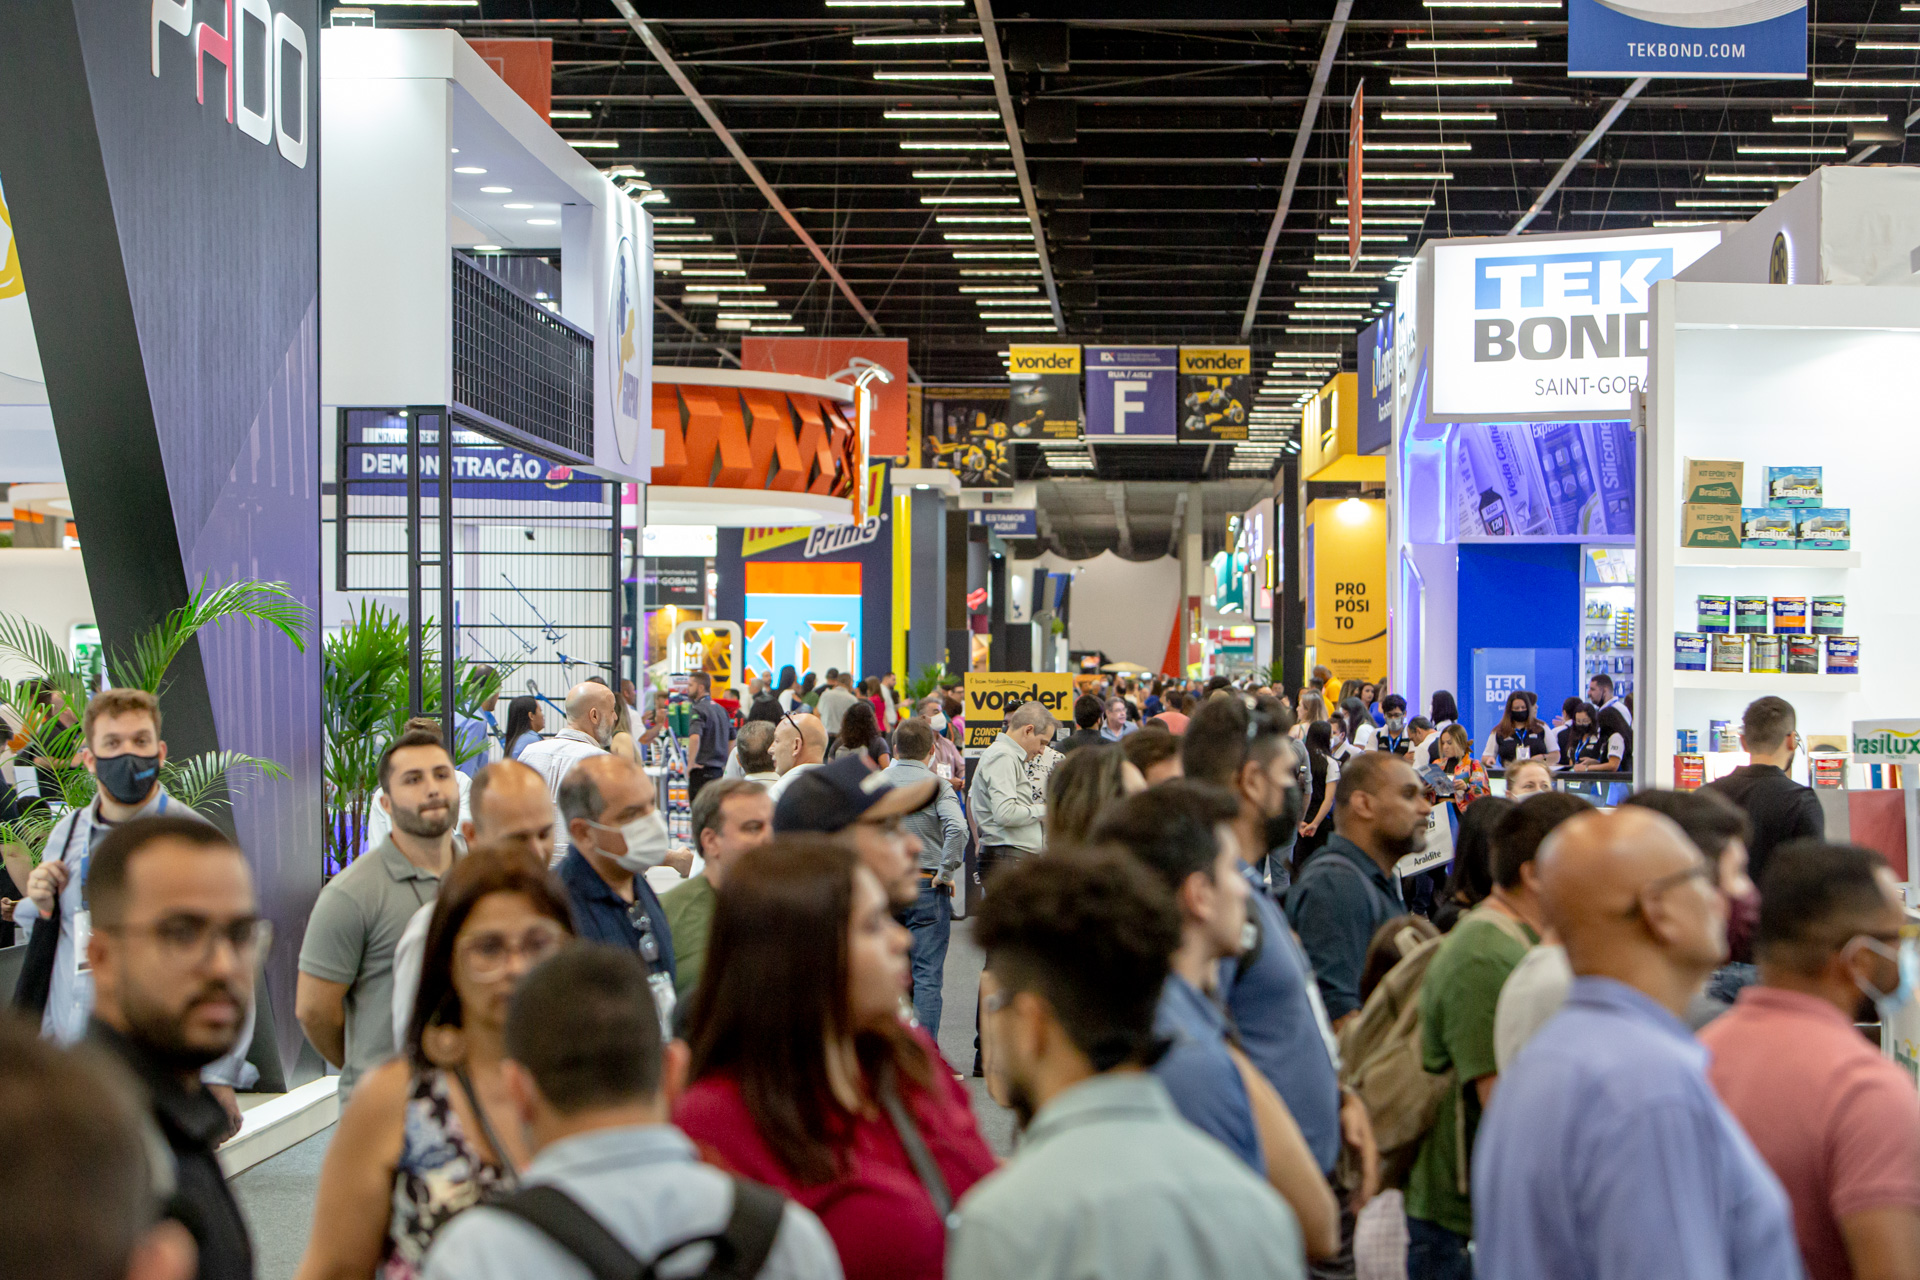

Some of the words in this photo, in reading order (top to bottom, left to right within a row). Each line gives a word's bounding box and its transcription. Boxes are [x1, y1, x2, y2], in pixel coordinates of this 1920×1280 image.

[1627, 43, 1746, 58] TEKBOND.COM
[1484, 256, 1664, 309] TEK
[1016, 352, 1074, 369] vonder
[1186, 352, 1245, 369] vonder
[1108, 371, 1126, 379] RUA
[1132, 371, 1153, 379] AISLE
[1535, 376, 1648, 396] SAINT-GOB
[1113, 381, 1148, 434] F
[1600, 422, 1620, 489] Silicone
[361, 452, 542, 480] DEMNTRAÇÃO
[1502, 463, 1518, 497] Veda
[1776, 487, 1817, 498] Brasilux
[985, 514, 1026, 522] ESTAMOS
[807, 517, 879, 556] Prime
[1749, 528, 1790, 539] Brasilux
[1804, 528, 1845, 539] Brasilux
[1335, 582, 1366, 595] PRO
[1335, 596, 1369, 612] PÓSI
[1335, 616, 1354, 629] TO
[1487, 677, 1523, 690] TEK
[970, 683, 1068, 710] vonder
[974, 728, 1002, 736] CONST
[972, 737, 993, 746] CIVIL
